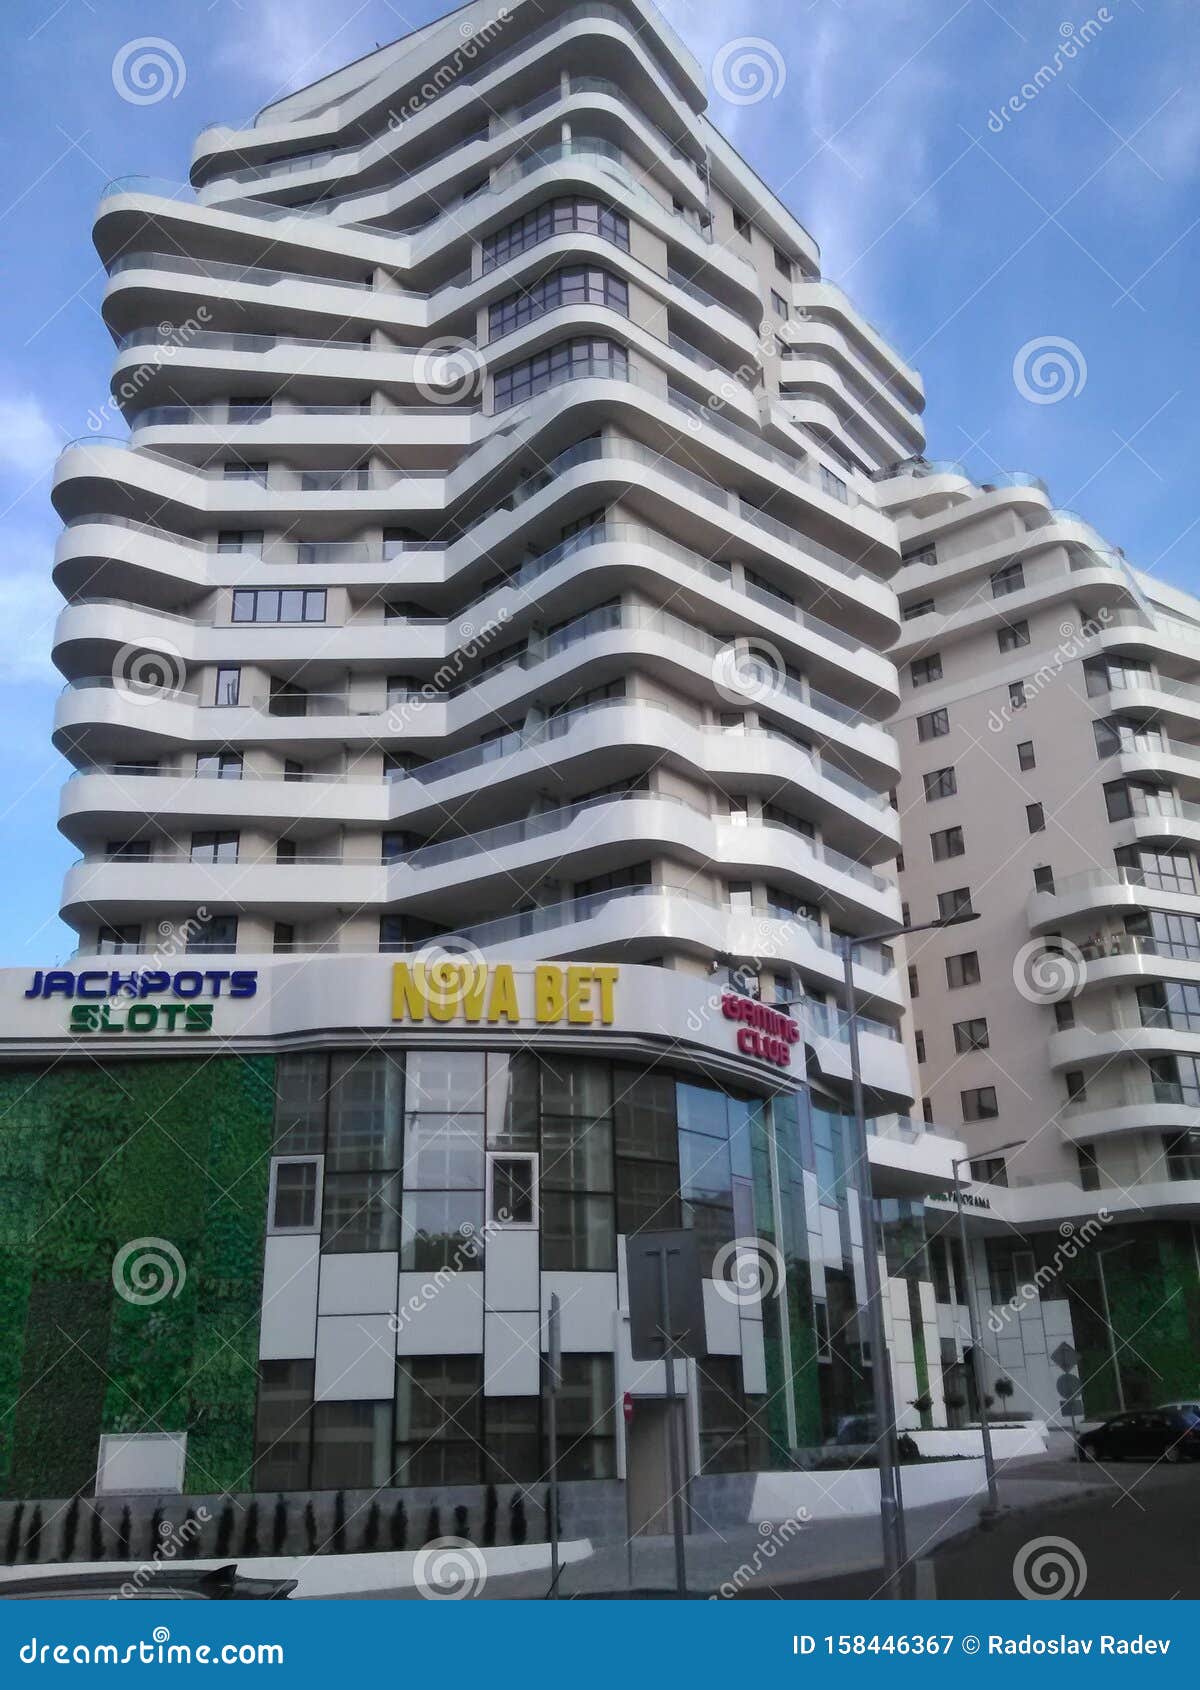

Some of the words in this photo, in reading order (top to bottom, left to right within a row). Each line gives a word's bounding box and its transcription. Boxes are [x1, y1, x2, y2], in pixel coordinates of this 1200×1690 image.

[24, 970, 258, 999] JACKPOTS
[392, 962, 520, 1022] NOVA
[535, 965, 619, 1025] BET
[70, 1004, 214, 1032] SLOTS
[721, 994, 800, 1044] GAMING
[737, 1027, 791, 1067] CLUB
